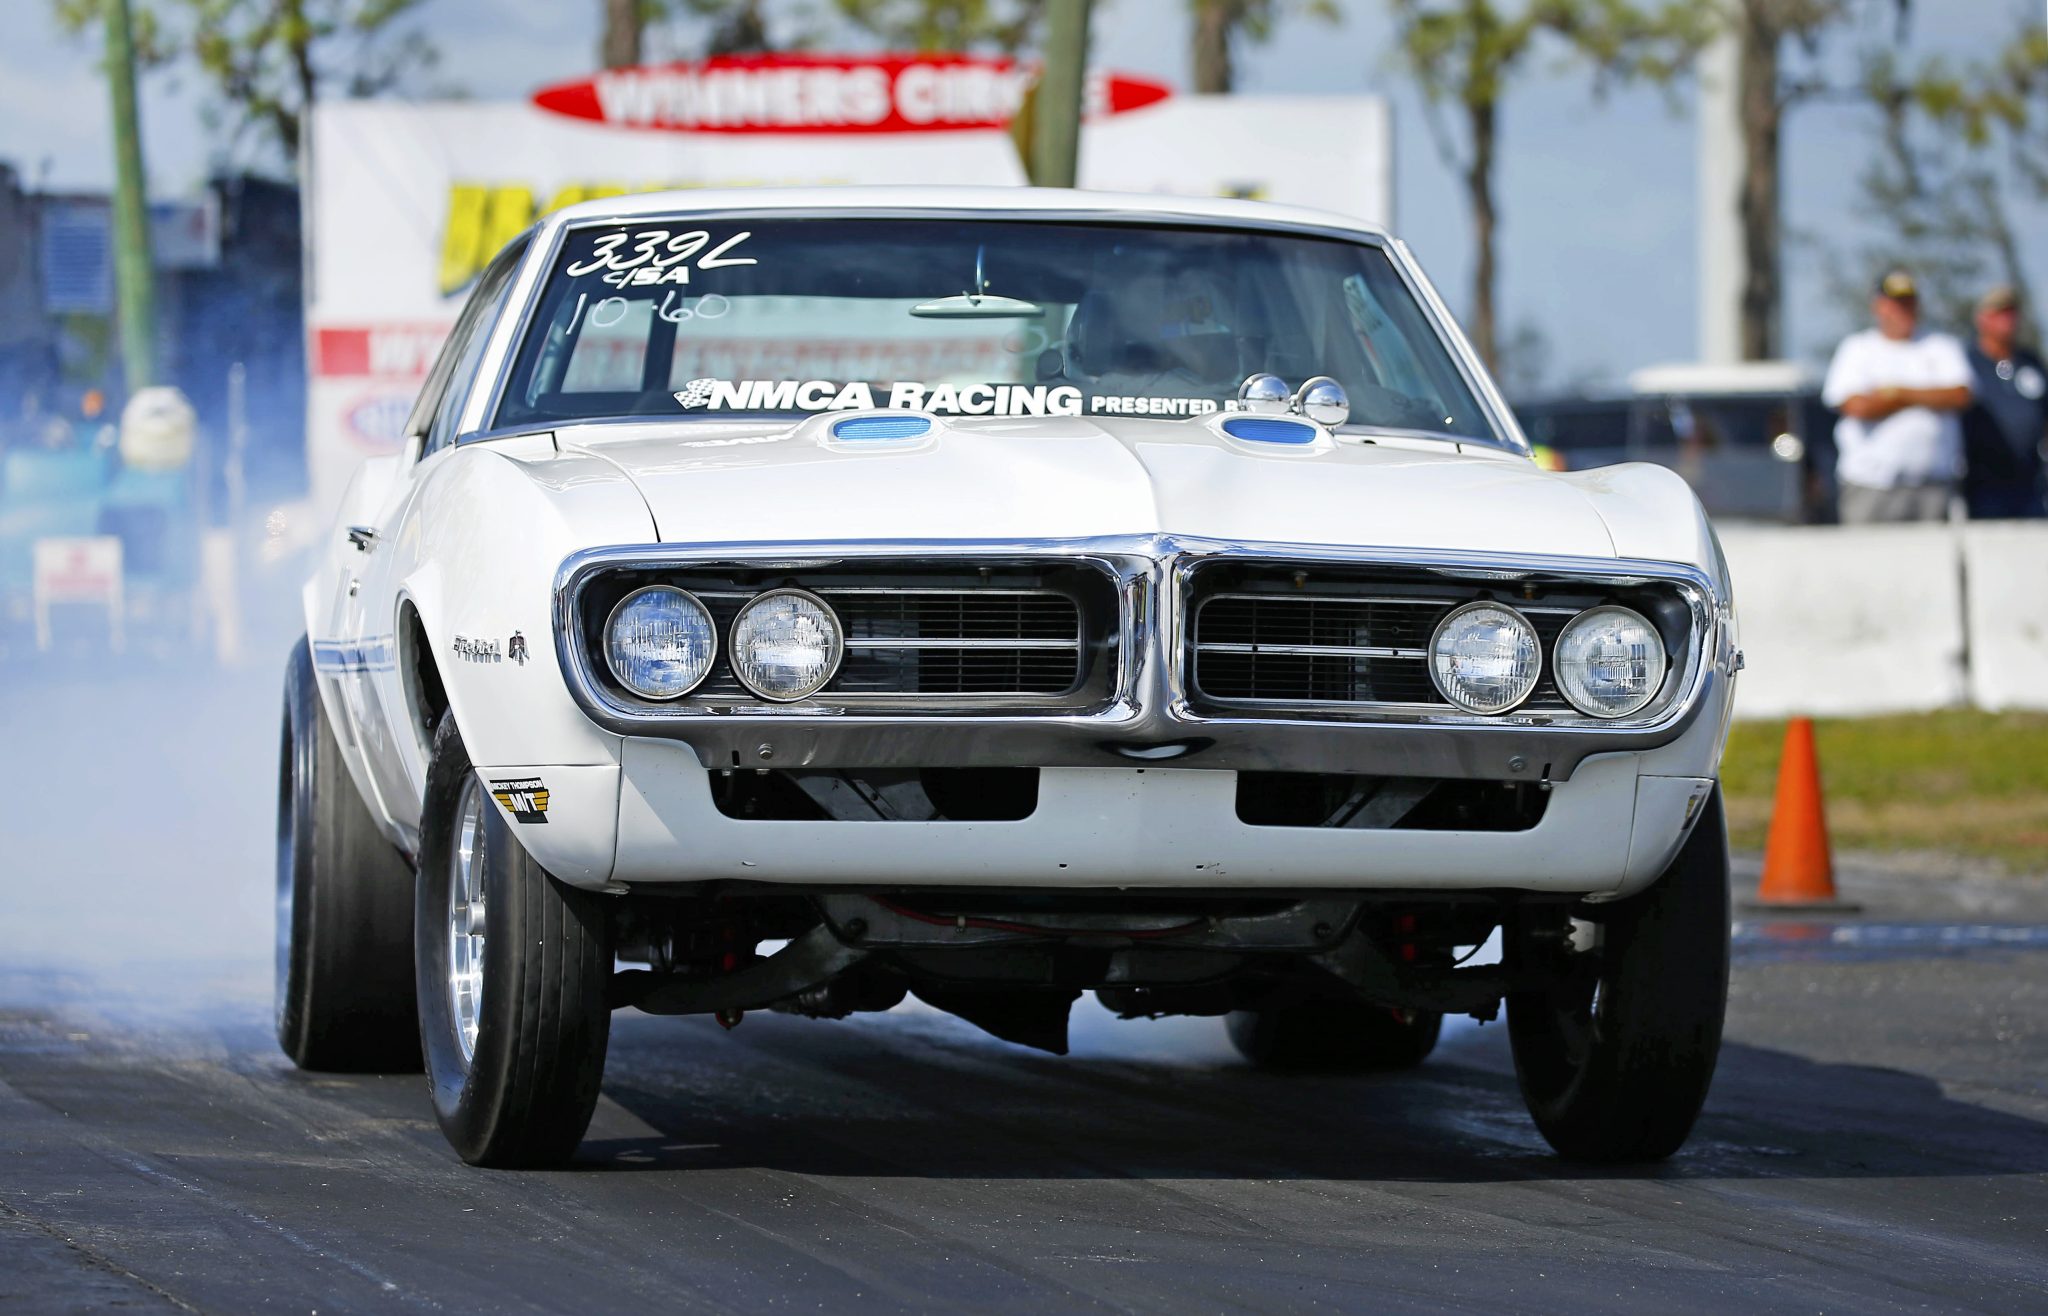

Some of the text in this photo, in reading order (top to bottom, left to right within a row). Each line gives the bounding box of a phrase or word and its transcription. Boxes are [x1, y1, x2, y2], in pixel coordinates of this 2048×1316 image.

[894, 62, 1110, 124] CIRE
[567, 230, 758, 277] 339L
[707, 379, 875, 411] NMCA
[888, 382, 1083, 416] RACING
[1091, 396, 1217, 415] PRESENTED
